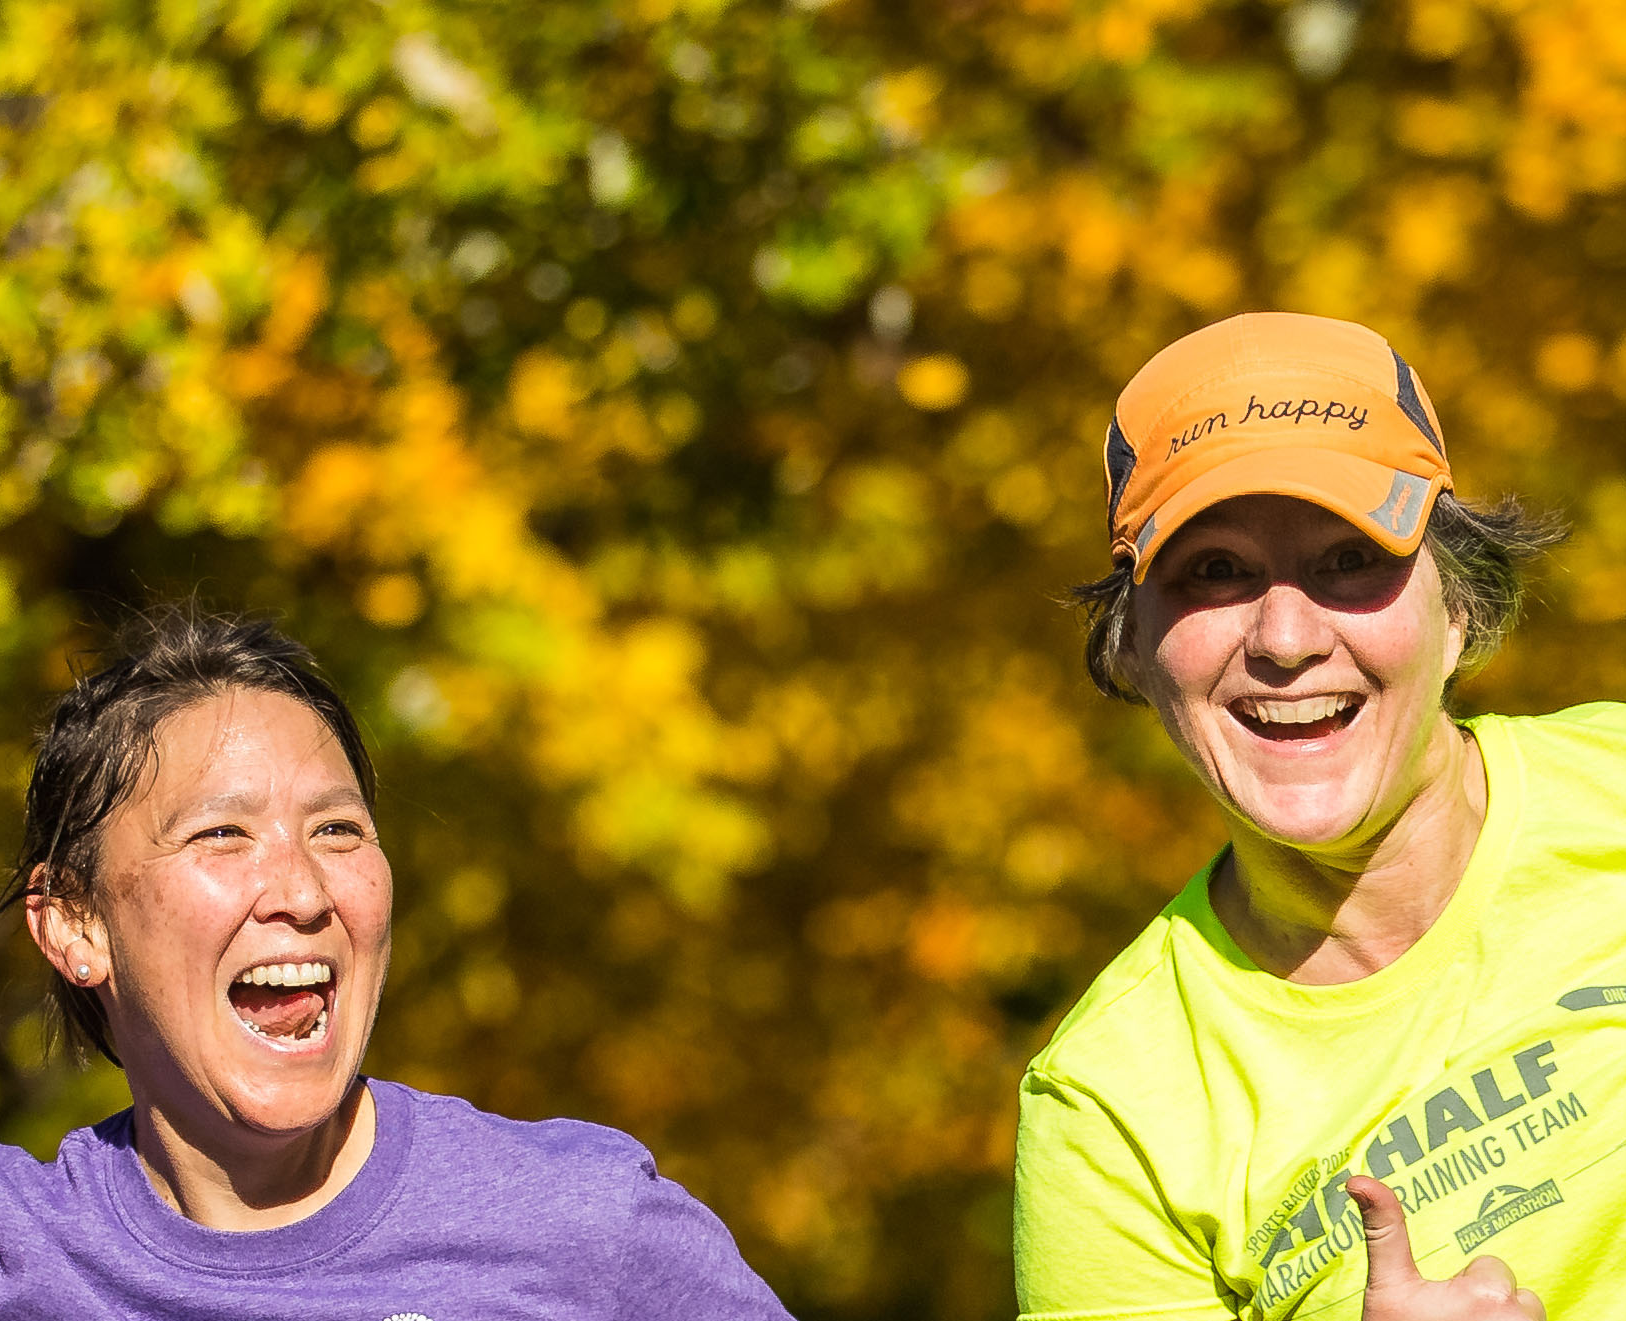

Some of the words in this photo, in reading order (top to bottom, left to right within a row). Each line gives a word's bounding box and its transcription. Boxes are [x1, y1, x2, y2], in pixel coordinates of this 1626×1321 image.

[1165, 412, 1229, 462] run
[1239, 395, 1369, 431] happy
[1366, 1040, 1559, 1181] HALF
[1393, 1136, 1506, 1214] RAINING
[1506, 1091, 1588, 1152] TEAM
[1246, 1209, 1286, 1257] SPORTS
[1460, 1222, 1491, 1250] HALF
[1492, 1187, 1562, 1232] MARATHON
